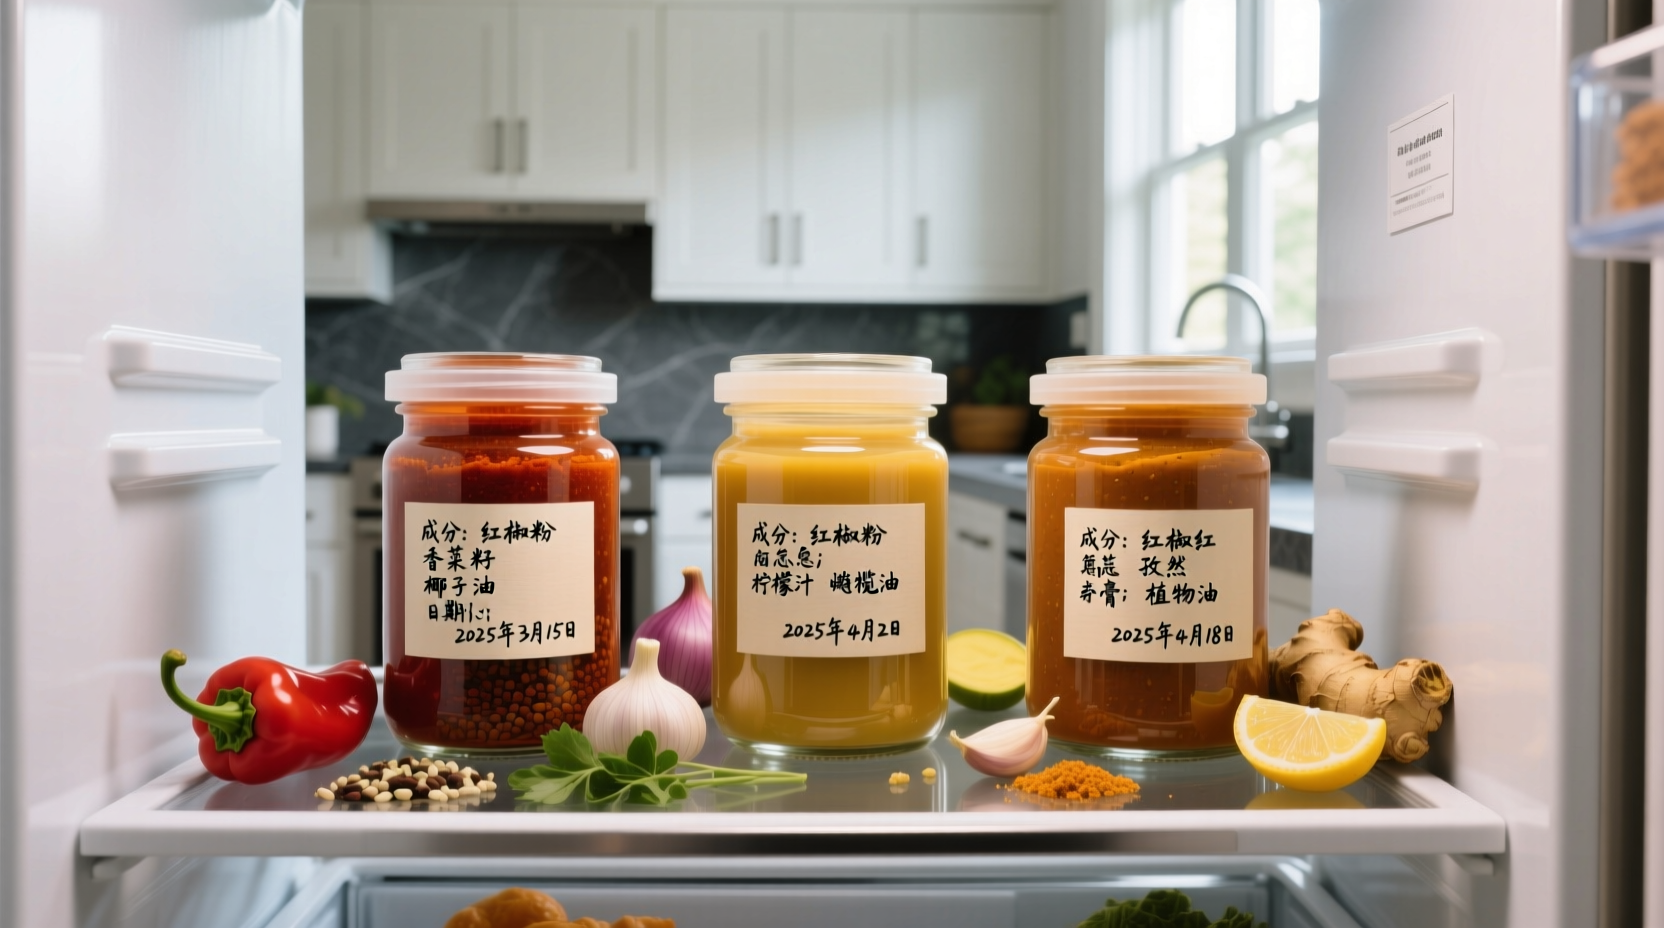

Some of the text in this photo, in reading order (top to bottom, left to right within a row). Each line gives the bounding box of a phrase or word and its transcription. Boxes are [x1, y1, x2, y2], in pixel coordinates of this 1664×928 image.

[481, 519, 557, 544] 红椒粉
[810, 523, 888, 547] 红椒粉
[1141, 528, 1216, 552] 红椒红
[423, 545, 496, 572] 香菜籽
[1138, 555, 1187, 578] 孜然
[424, 575, 495, 598] 椰子油
[751, 571, 814, 596] 柠檬汁
[1145, 581, 1219, 605] 植物油
[454, 620, 576, 648] 2025年3月15日
[782, 617, 900, 646] 2025年4月2日
[1111, 621, 1234, 650] 2025年4月18日
